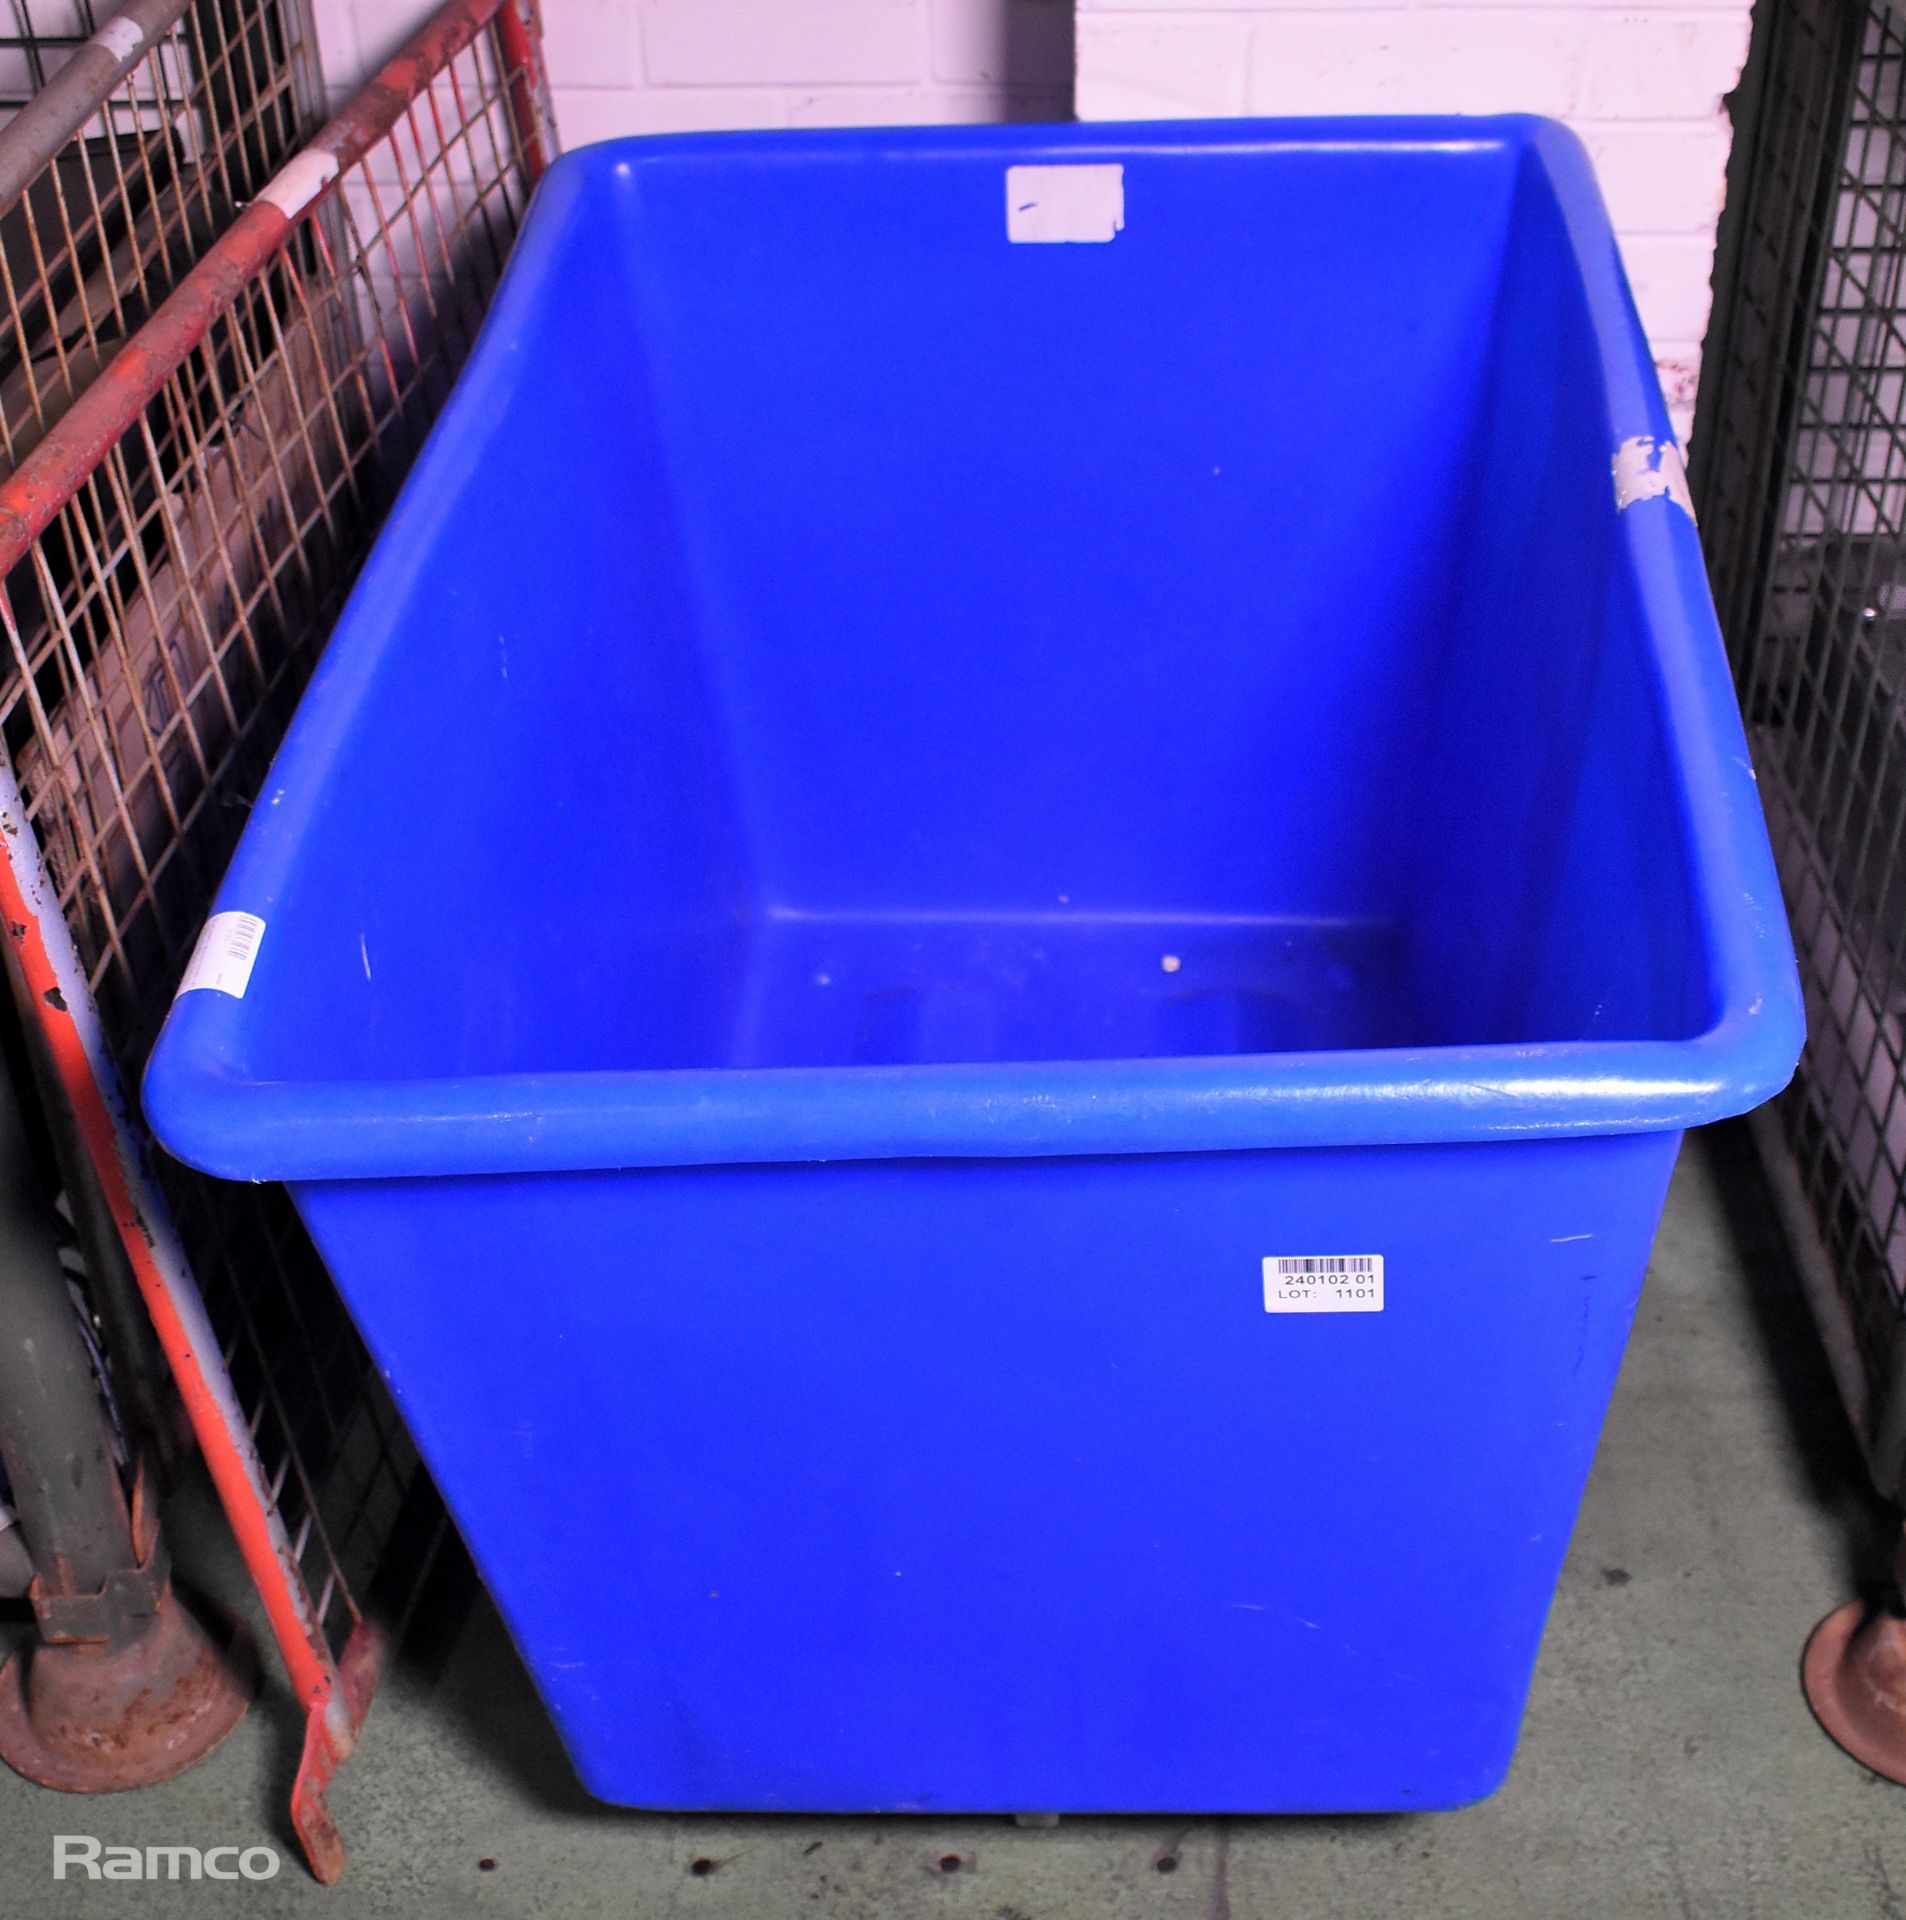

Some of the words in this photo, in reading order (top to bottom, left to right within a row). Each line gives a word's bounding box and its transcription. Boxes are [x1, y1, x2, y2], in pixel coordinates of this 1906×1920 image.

[1285, 1275, 1349, 1285] 240102
[1355, 1274, 1375, 1285] 01
[1278, 1289, 1317, 1299] LOT:
[1335, 1288, 1375, 1298] 1101
